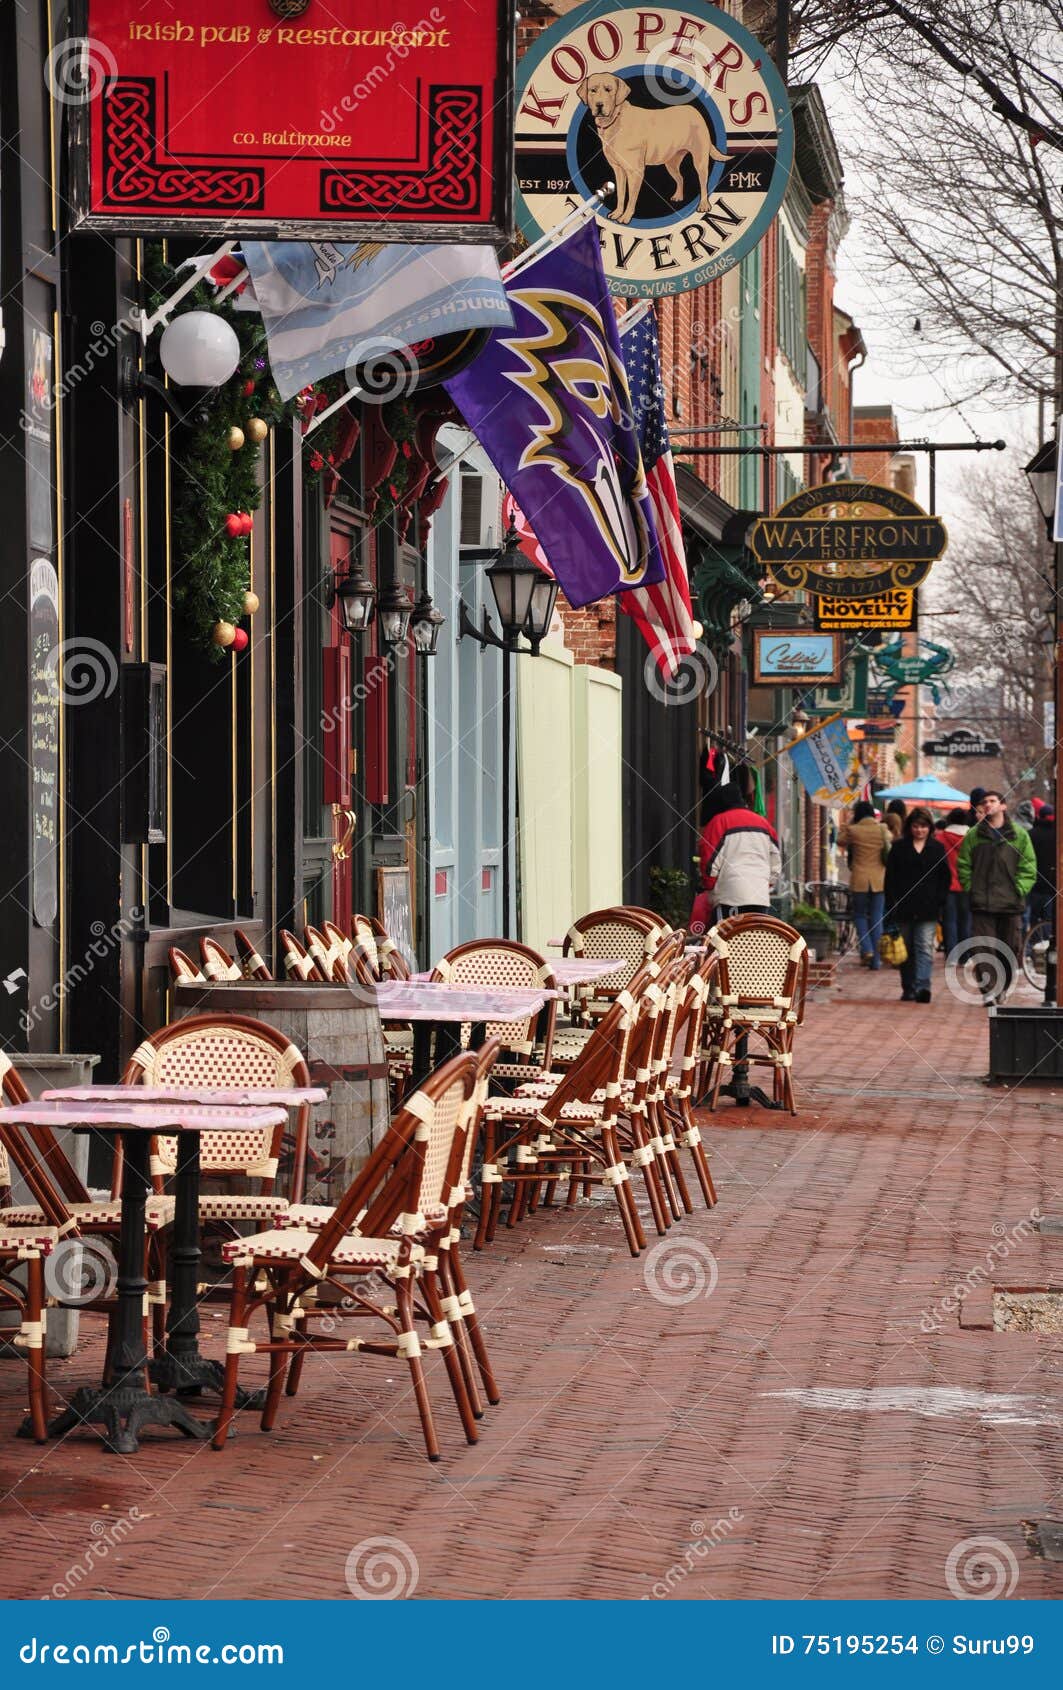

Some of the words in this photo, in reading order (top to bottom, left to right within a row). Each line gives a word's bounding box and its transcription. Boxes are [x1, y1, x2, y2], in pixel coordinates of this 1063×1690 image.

[520, 12, 769, 129] KOOPER'S
[519, 179, 541, 189] EST
[729, 172, 763, 189] PMK
[820, 547, 879, 559] HOTEL
[821, 591, 908, 604] GHIC
[823, 604, 909, 616] NOVELTY
